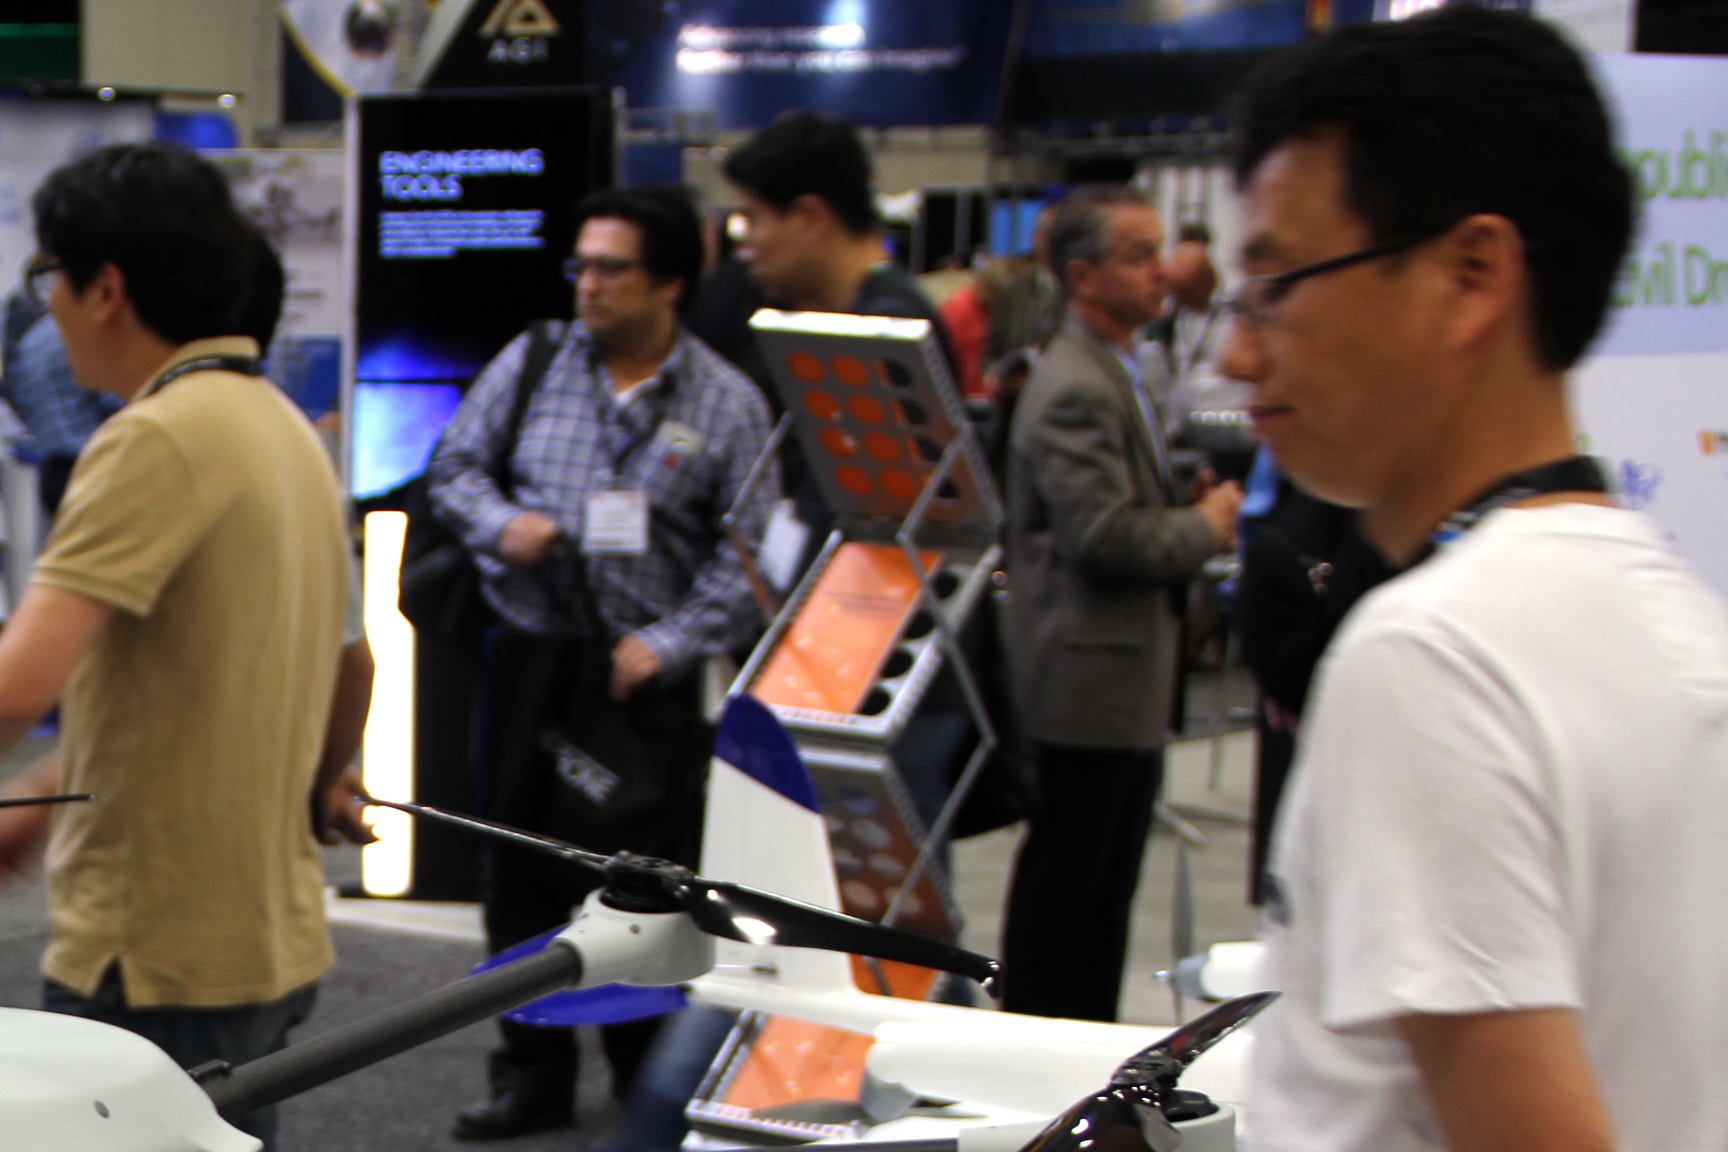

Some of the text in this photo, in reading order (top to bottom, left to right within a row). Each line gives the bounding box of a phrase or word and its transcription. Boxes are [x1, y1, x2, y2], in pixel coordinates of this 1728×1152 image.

[486, 37, 549, 61] AGI
[379, 149, 545, 176] ENGINEERING
[379, 174, 463, 200] TOOLS
